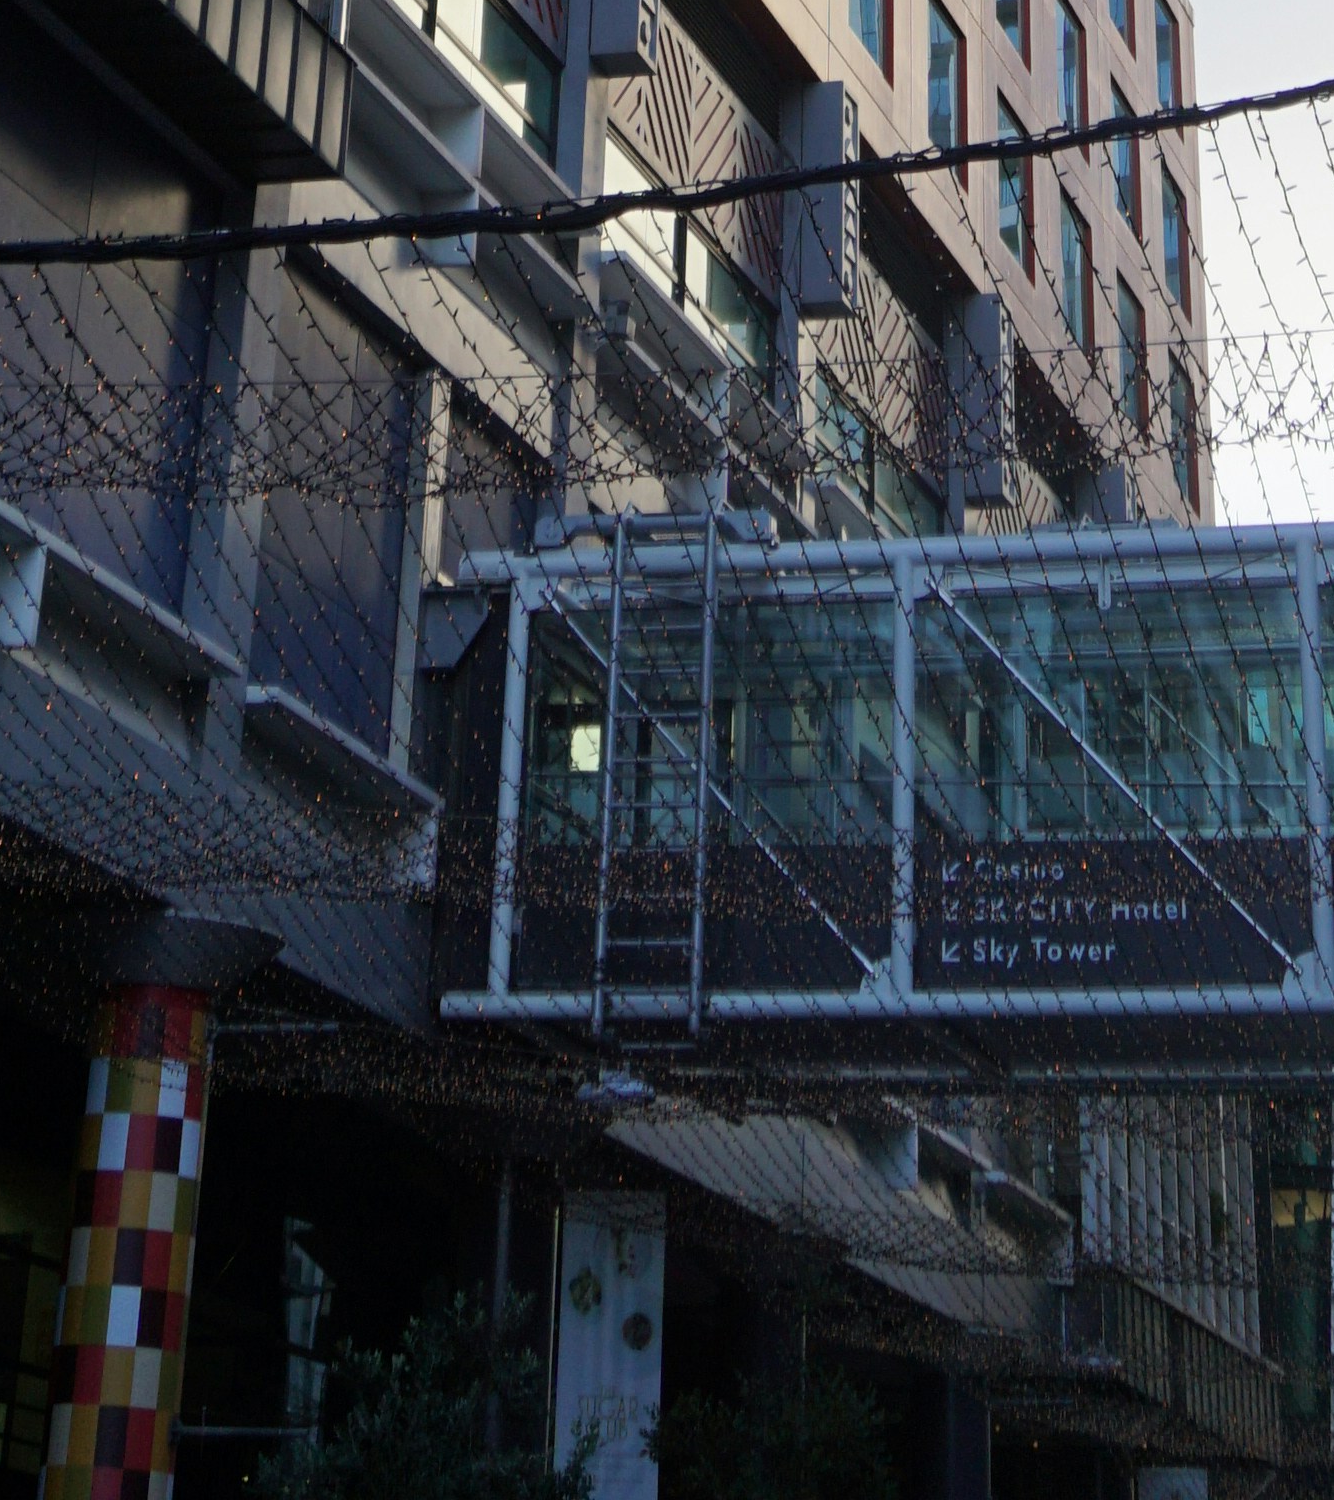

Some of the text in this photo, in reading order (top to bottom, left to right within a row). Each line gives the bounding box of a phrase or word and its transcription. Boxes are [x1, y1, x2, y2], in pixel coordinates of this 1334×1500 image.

[1110, 895, 1188, 922] Hotel
[972, 936, 1116, 969] Sky Tower
